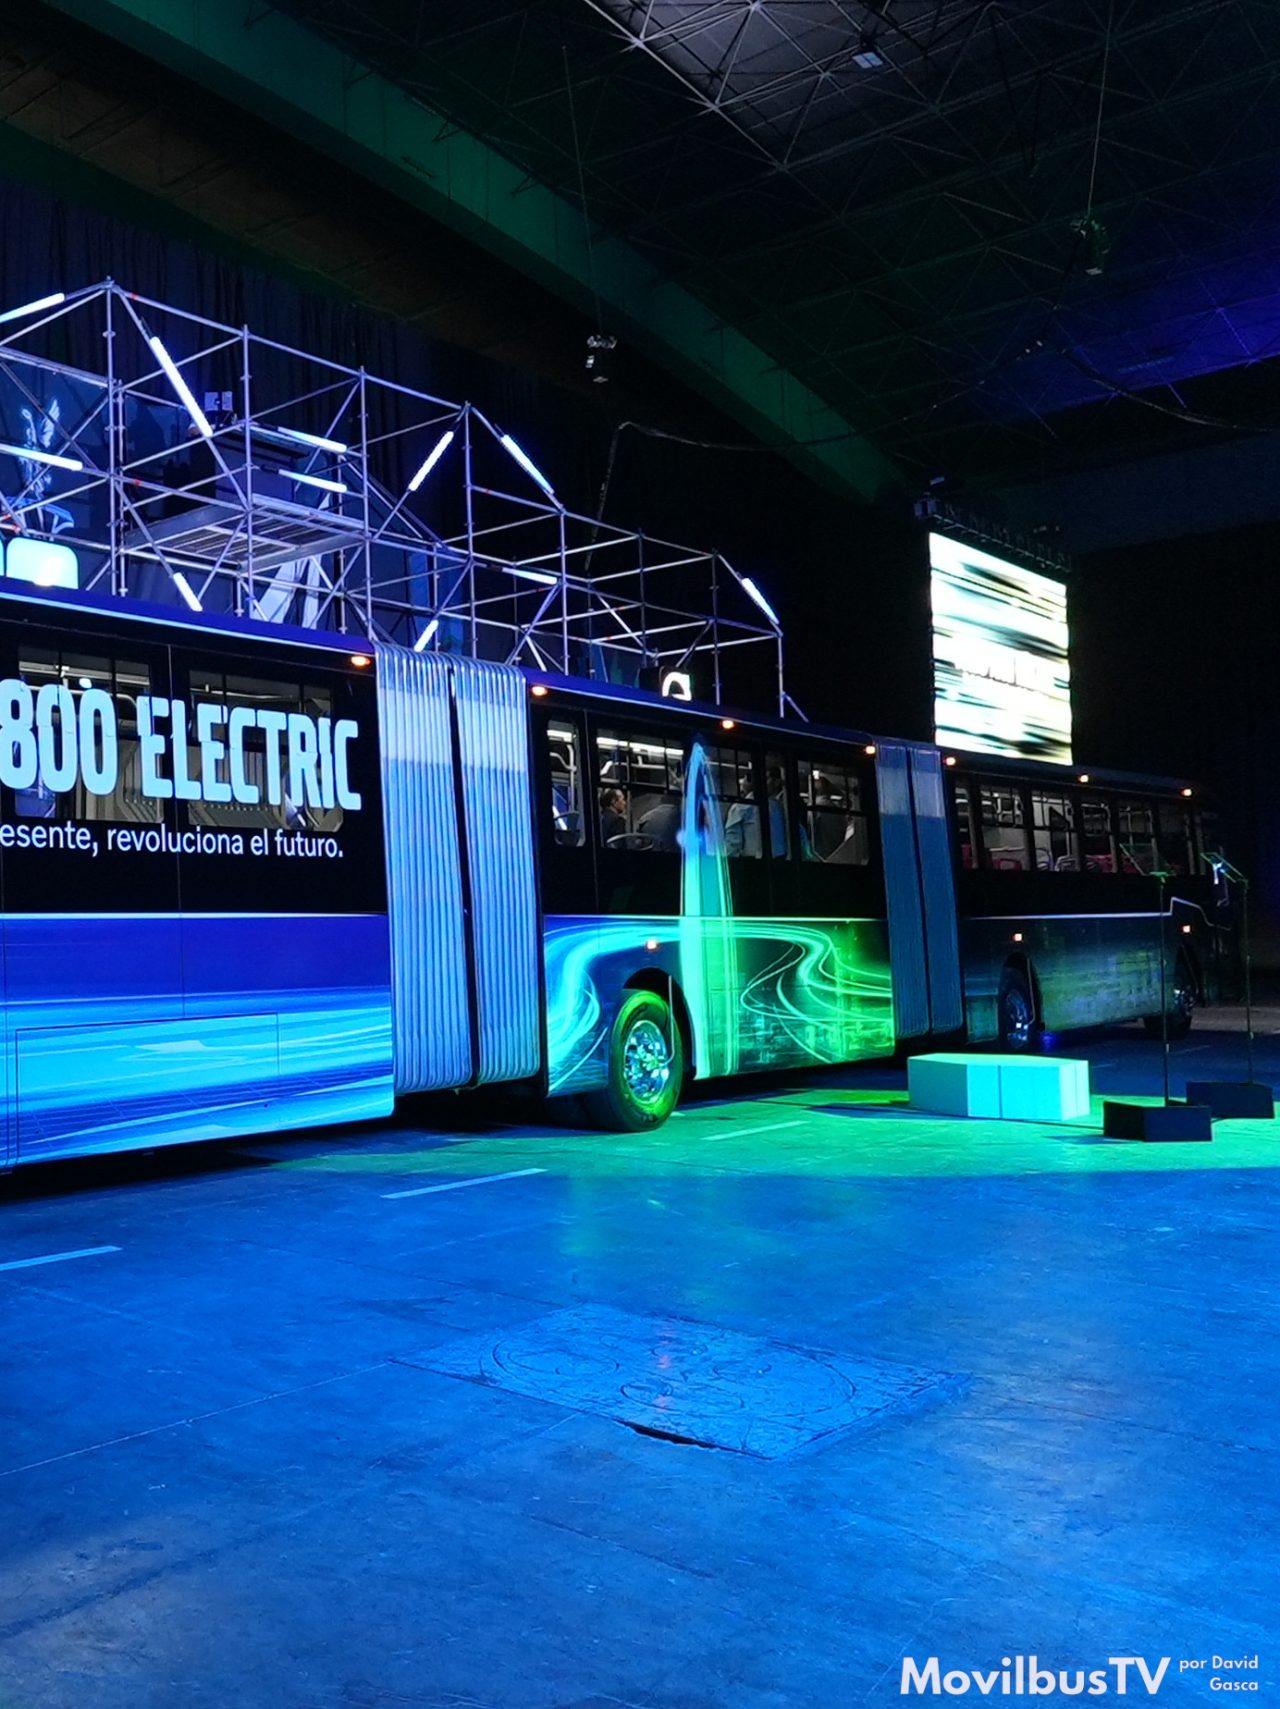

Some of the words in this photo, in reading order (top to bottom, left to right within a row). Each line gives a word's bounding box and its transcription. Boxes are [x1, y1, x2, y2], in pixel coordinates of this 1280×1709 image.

[137, 695, 362, 811] ELECTRIC
[107, 823, 244, 855] revoluciona
[250, 827, 269, 856] el
[274, 827, 344, 858] futuro.
